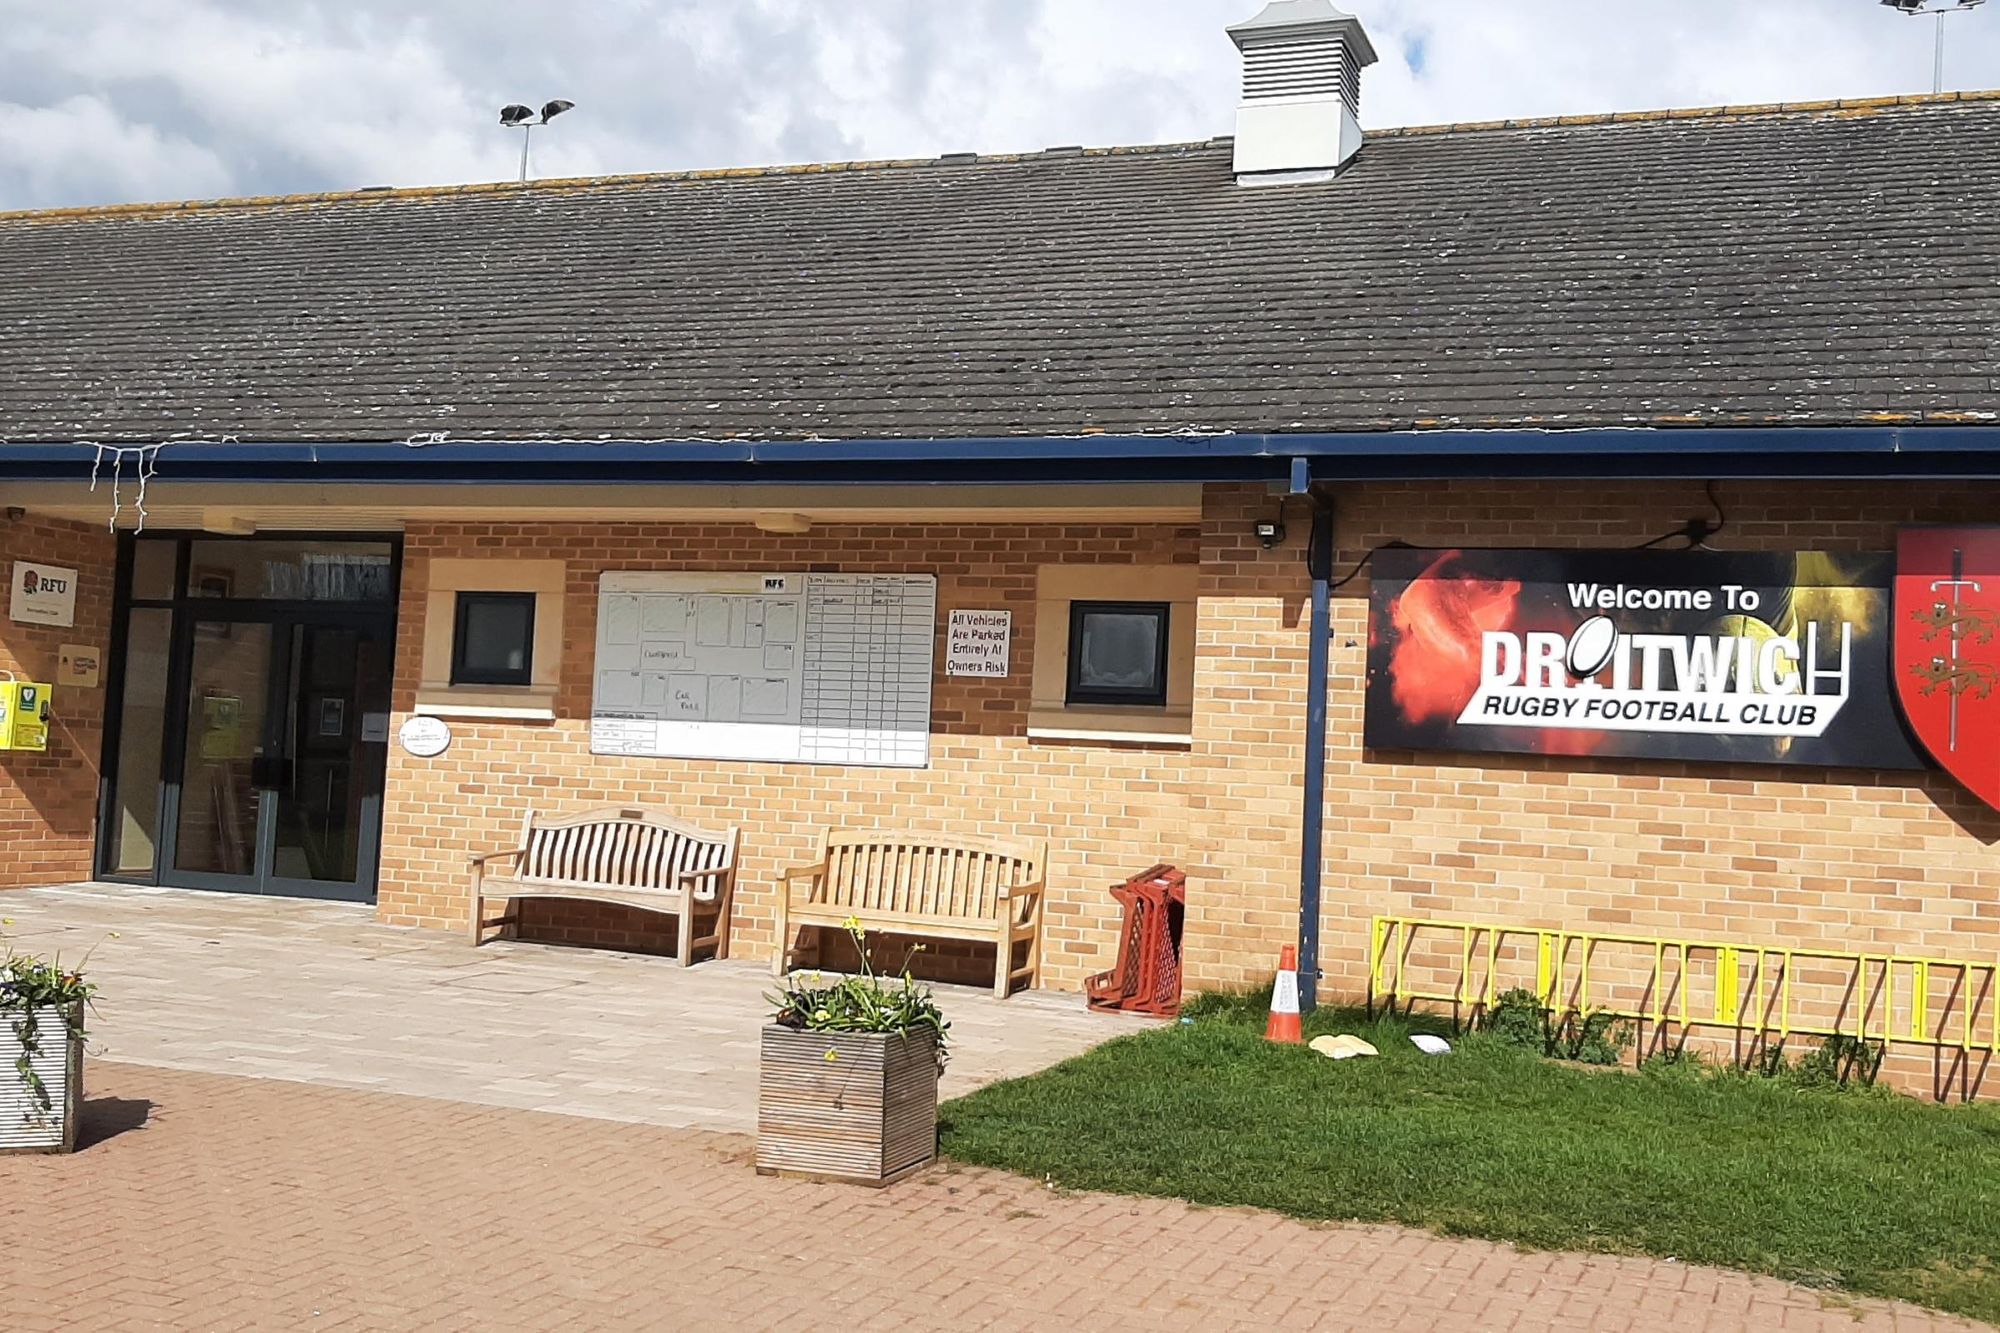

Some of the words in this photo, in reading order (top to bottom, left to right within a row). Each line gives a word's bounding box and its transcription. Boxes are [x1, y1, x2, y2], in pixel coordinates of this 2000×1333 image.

[40, 577, 67, 594] RFU
[1567, 583, 1712, 610] Welcome
[1720, 585, 1760, 611] To
[952, 614, 965, 626] All
[967, 614, 1007, 627] Vehicles
[952, 628, 969, 640] Are
[971, 629, 1006, 641] Parked
[953, 643, 990, 657] Entirely
[992, 643, 1003, 656] At
[1480, 614, 1852, 697] DROITWICH
[947, 660, 982, 672] Owners
[985, 661, 1006, 673] Risk
[1483, 695, 1579, 718] RUGBY
[1584, 698, 1731, 723] FOOTBALL
[1739, 703, 1818, 726] CLUB
